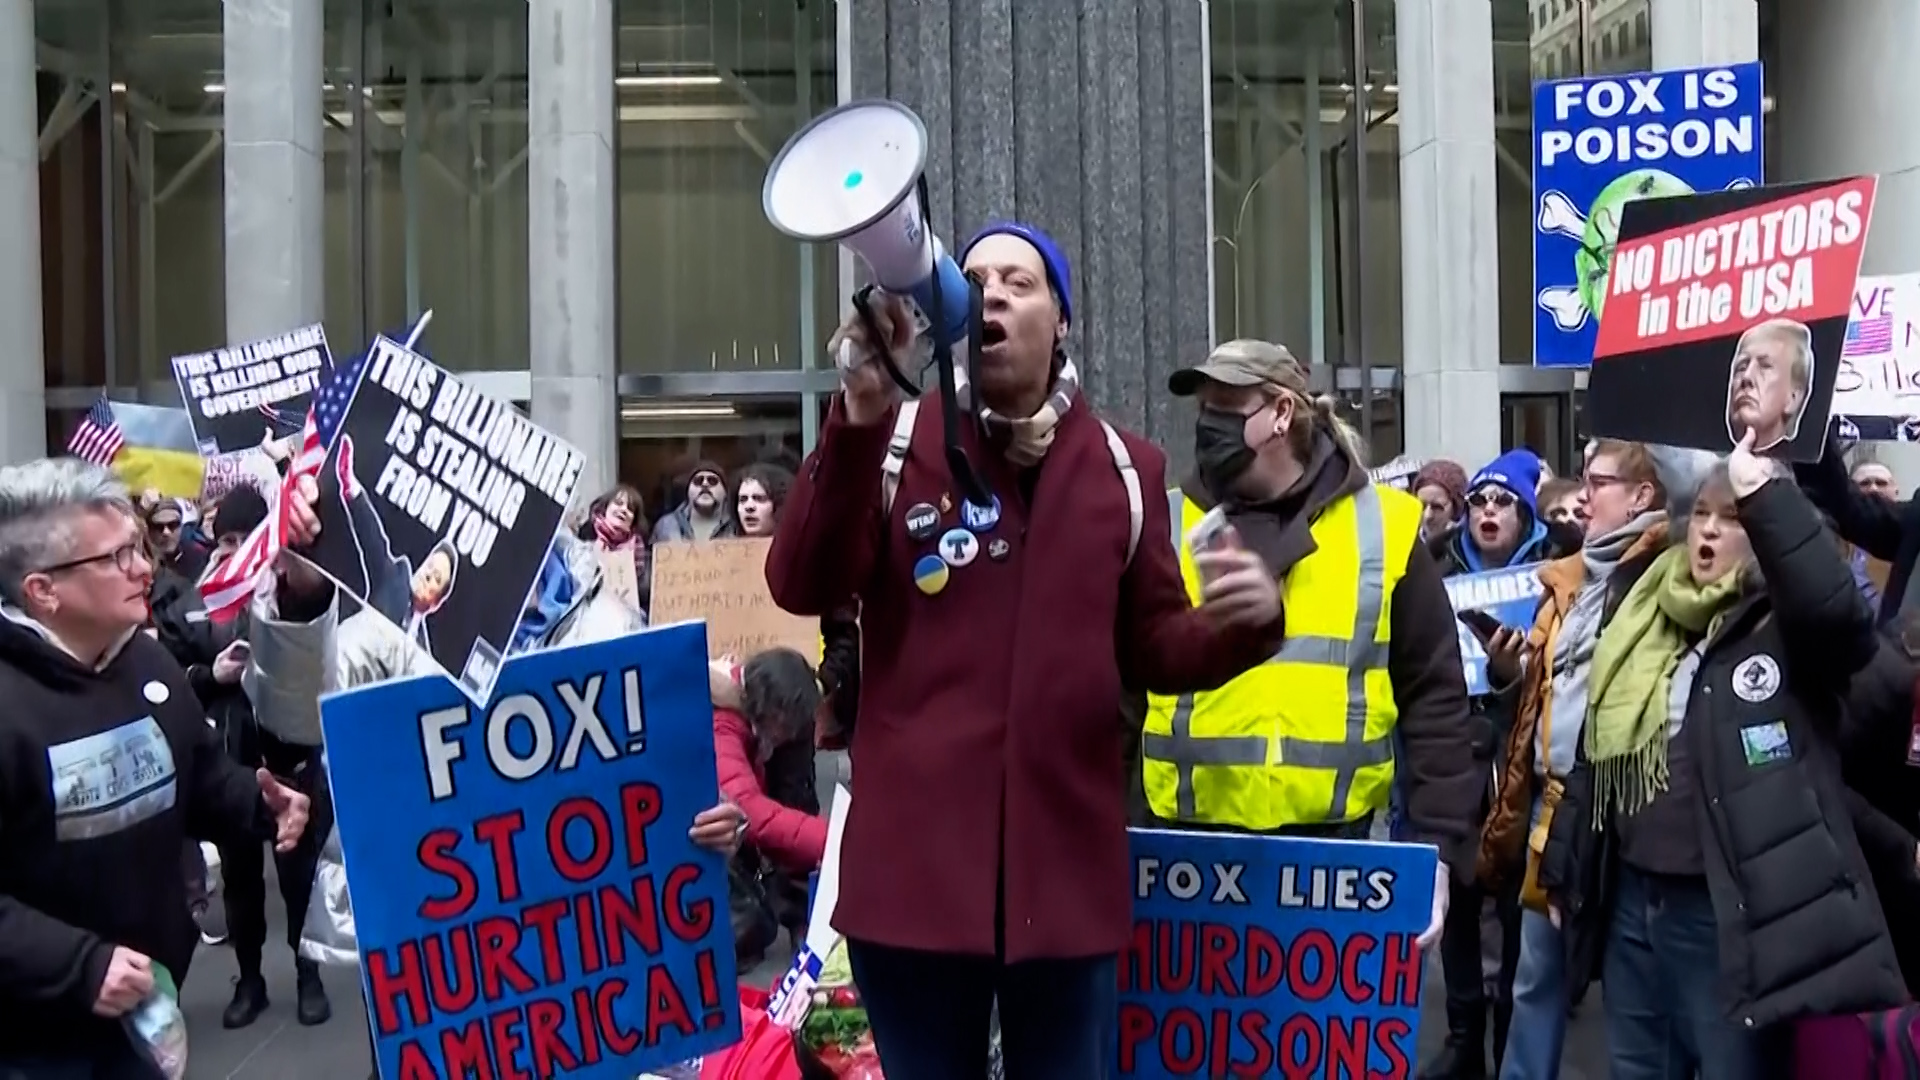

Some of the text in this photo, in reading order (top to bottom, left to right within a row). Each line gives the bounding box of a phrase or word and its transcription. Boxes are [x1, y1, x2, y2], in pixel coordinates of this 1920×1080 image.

[1555, 70, 1738, 120] FOX IS
[1541, 115, 1752, 166] POISON
[1613, 190, 1863, 296] NO DICTATORS
[1638, 257, 1813, 338] in the USA
[1852, 287, 1895, 316] VE
[177, 325, 324, 377] THIS BILLIONAIRE
[188, 349, 322, 398] IS KILLING OUR
[201, 370, 320, 418] GOVERNMENT
[369, 341, 585, 507] THIS BILLIONAIRE
[375, 453, 498, 567] FROM YOU
[384, 405, 526, 531] IS STEALING
[419, 664, 647, 801] FOX!
[417, 782, 663, 920] STOP
[1137, 857, 1396, 911] FOX LIES
[367, 863, 713, 1037] HURTING
[1117, 919, 1423, 1006] MURDOCH
[398, 951, 726, 1080] AMERICA!
[1118, 1003, 1411, 1080] POISONS
